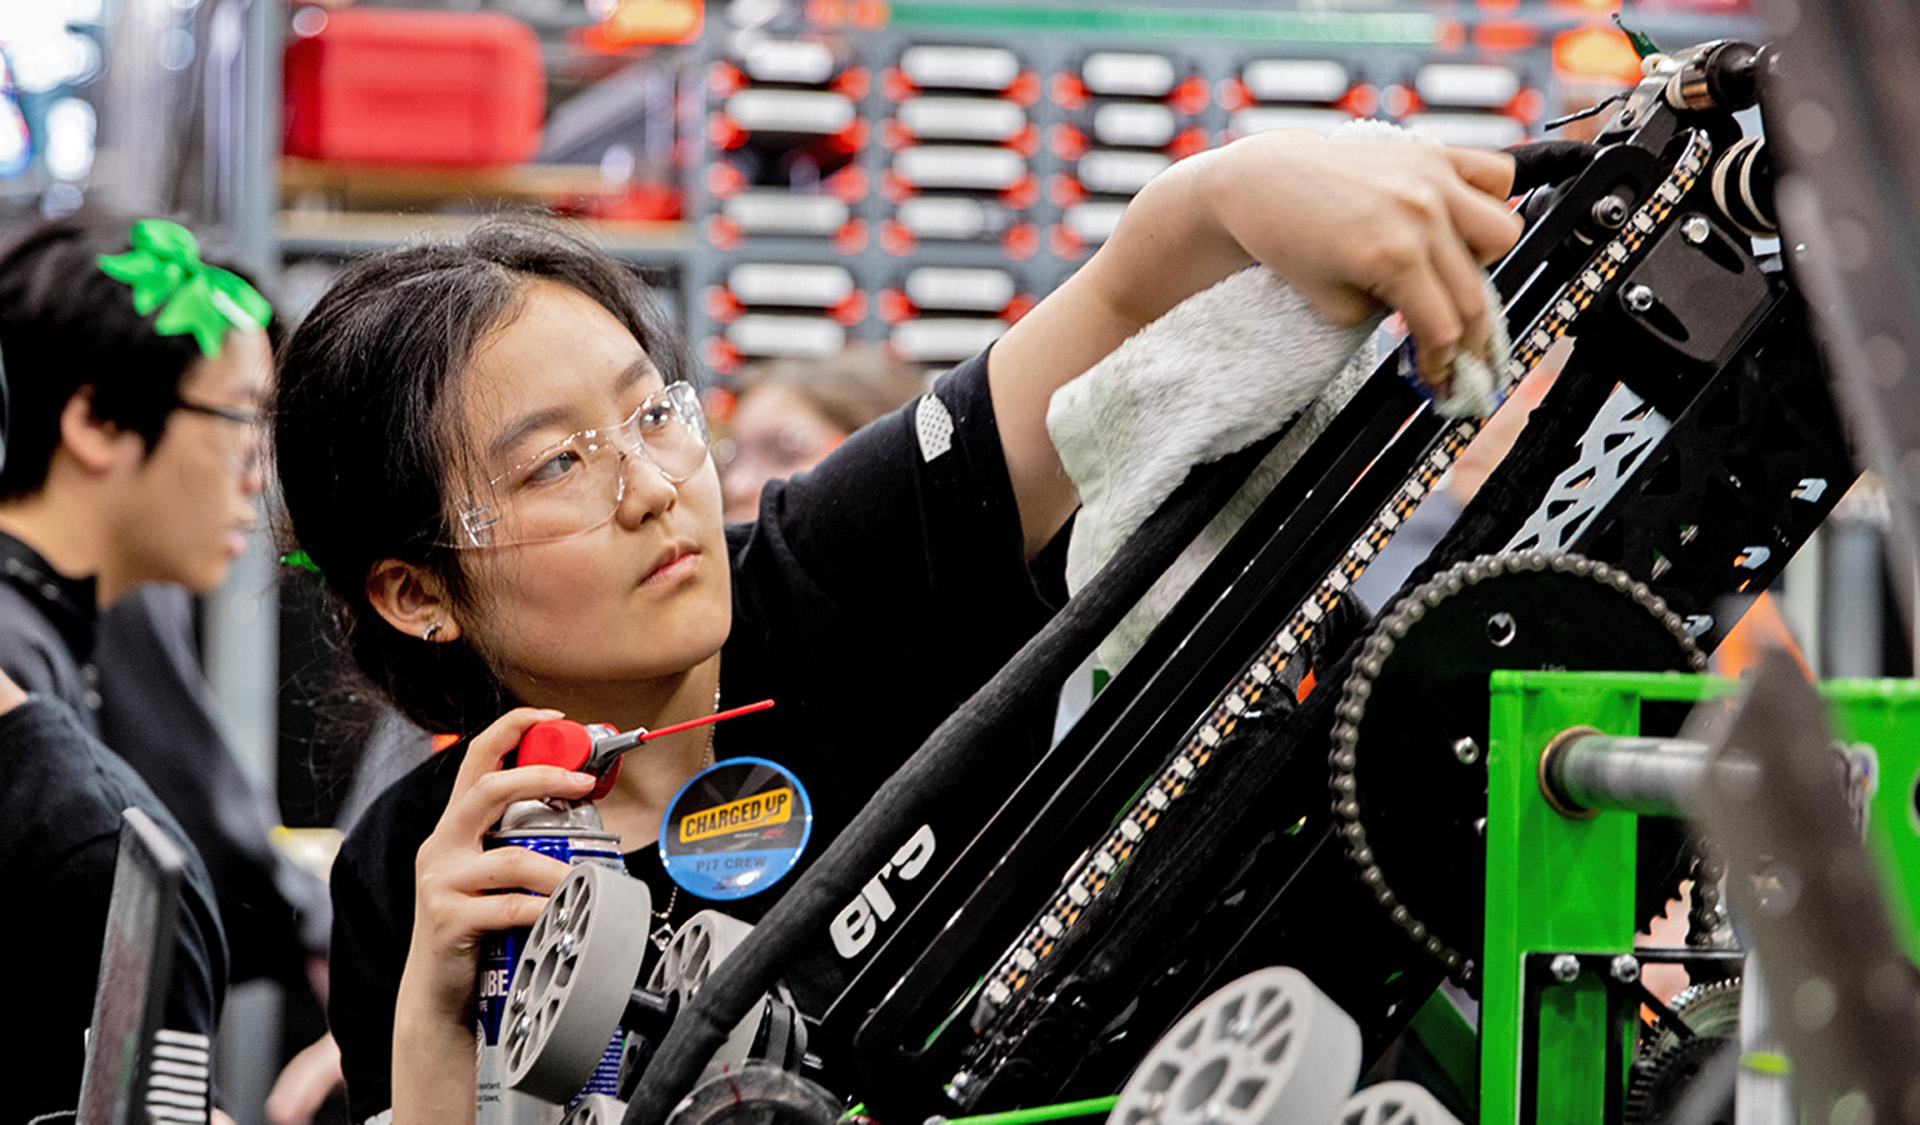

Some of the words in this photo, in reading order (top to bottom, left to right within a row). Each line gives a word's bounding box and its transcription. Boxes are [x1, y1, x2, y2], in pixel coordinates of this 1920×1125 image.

[685, 798, 762, 837] CHARGED
[765, 793, 788, 815] UP
[696, 857, 719, 871] PIT
[724, 856, 767, 870] CREW
